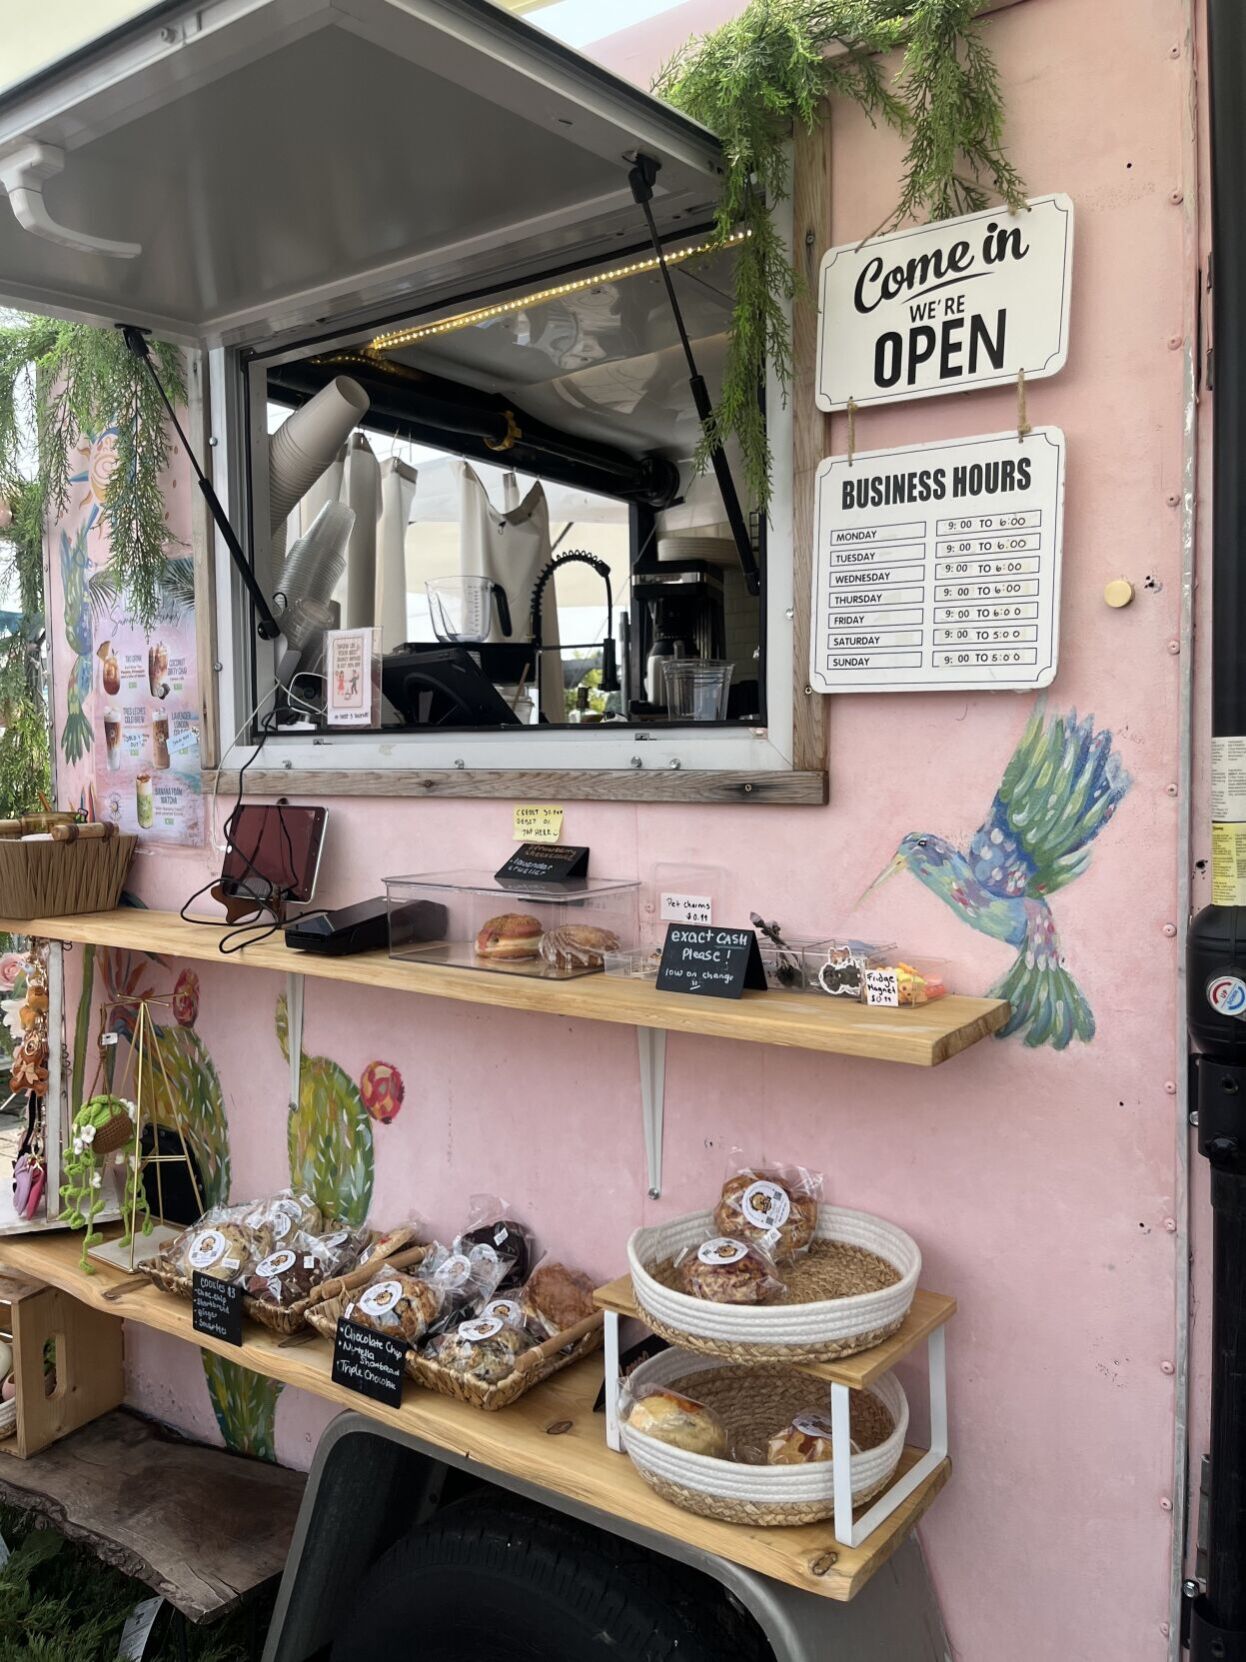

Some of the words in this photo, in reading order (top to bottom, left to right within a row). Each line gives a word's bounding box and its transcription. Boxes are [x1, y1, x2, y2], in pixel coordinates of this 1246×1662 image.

[854, 241, 975, 314] Come
[982, 222, 1029, 264] in
[909, 295, 965, 323] WE'RE
[874, 308, 1007, 388] OPEN
[841, 468, 946, 510] BUSINESS
[952, 457, 1031, 498] HOURS
[979, 519, 993, 528] TO
[836, 530, 877, 542] MONDAY
[979, 541, 992, 551] TO
[836, 552, 875, 564] TUESDAY
[978, 564, 991, 573] TO
[835, 572, 890, 584] WEDNESDAY
[977, 587, 991, 596] TO
[835, 594, 882, 604] THURSDAY
[976, 609, 990, 618] TO
[834, 616, 865, 625] FRIDAY
[975, 631, 989, 640] TO
[833, 636, 880, 646] SATURDAY
[833, 657, 870, 667] SUNDAY
[975, 653, 988, 662] TO
[716, 932, 748, 946] CASH
[344, 1324, 383, 1350] Chocolate
